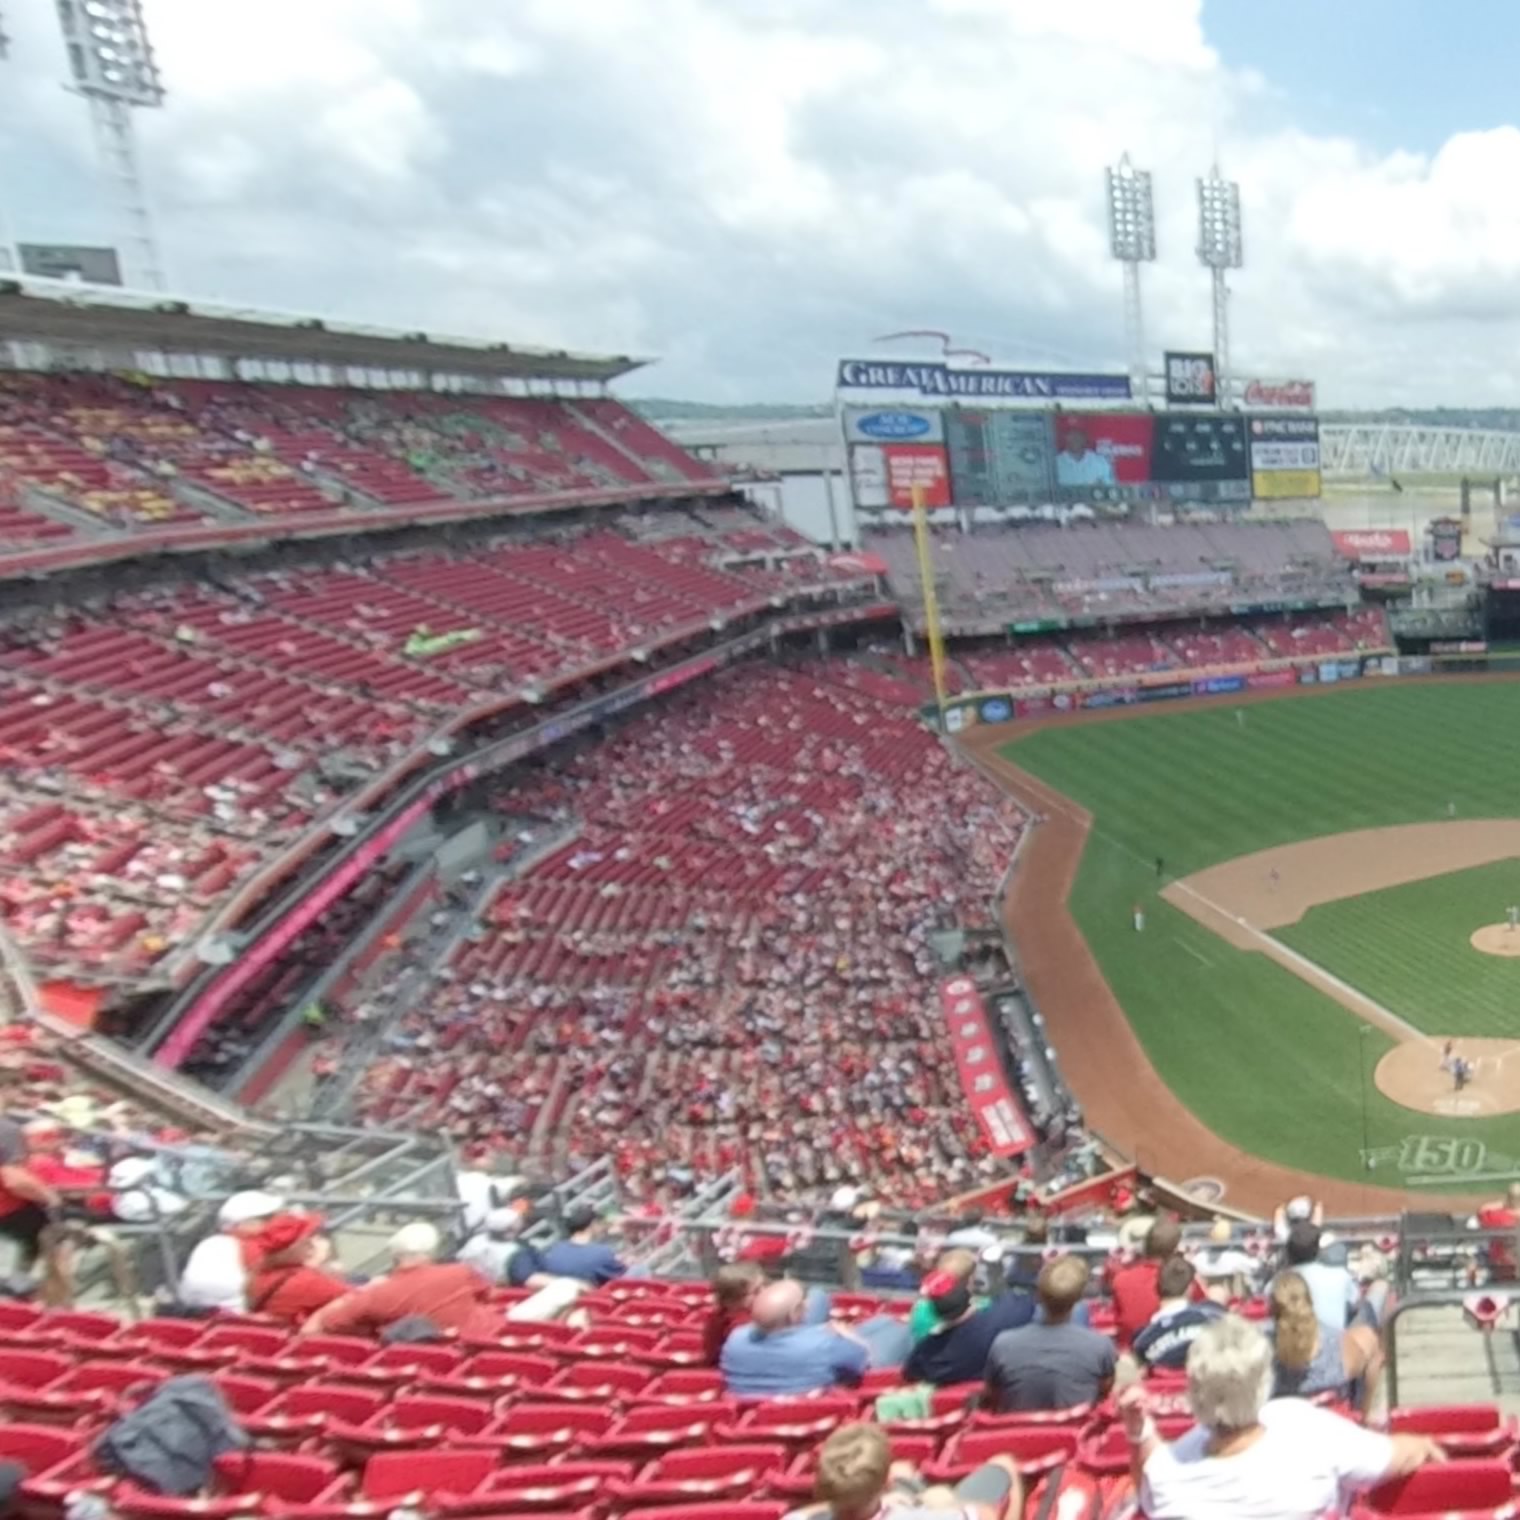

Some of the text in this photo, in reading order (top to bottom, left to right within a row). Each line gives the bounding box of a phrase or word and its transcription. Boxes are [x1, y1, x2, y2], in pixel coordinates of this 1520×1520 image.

[843, 362, 934, 386] GREAT
[927, 370, 1050, 393] AMERICAN
[1169, 358, 1207, 377] BIG
[1399, 1135, 1485, 1173] 150
